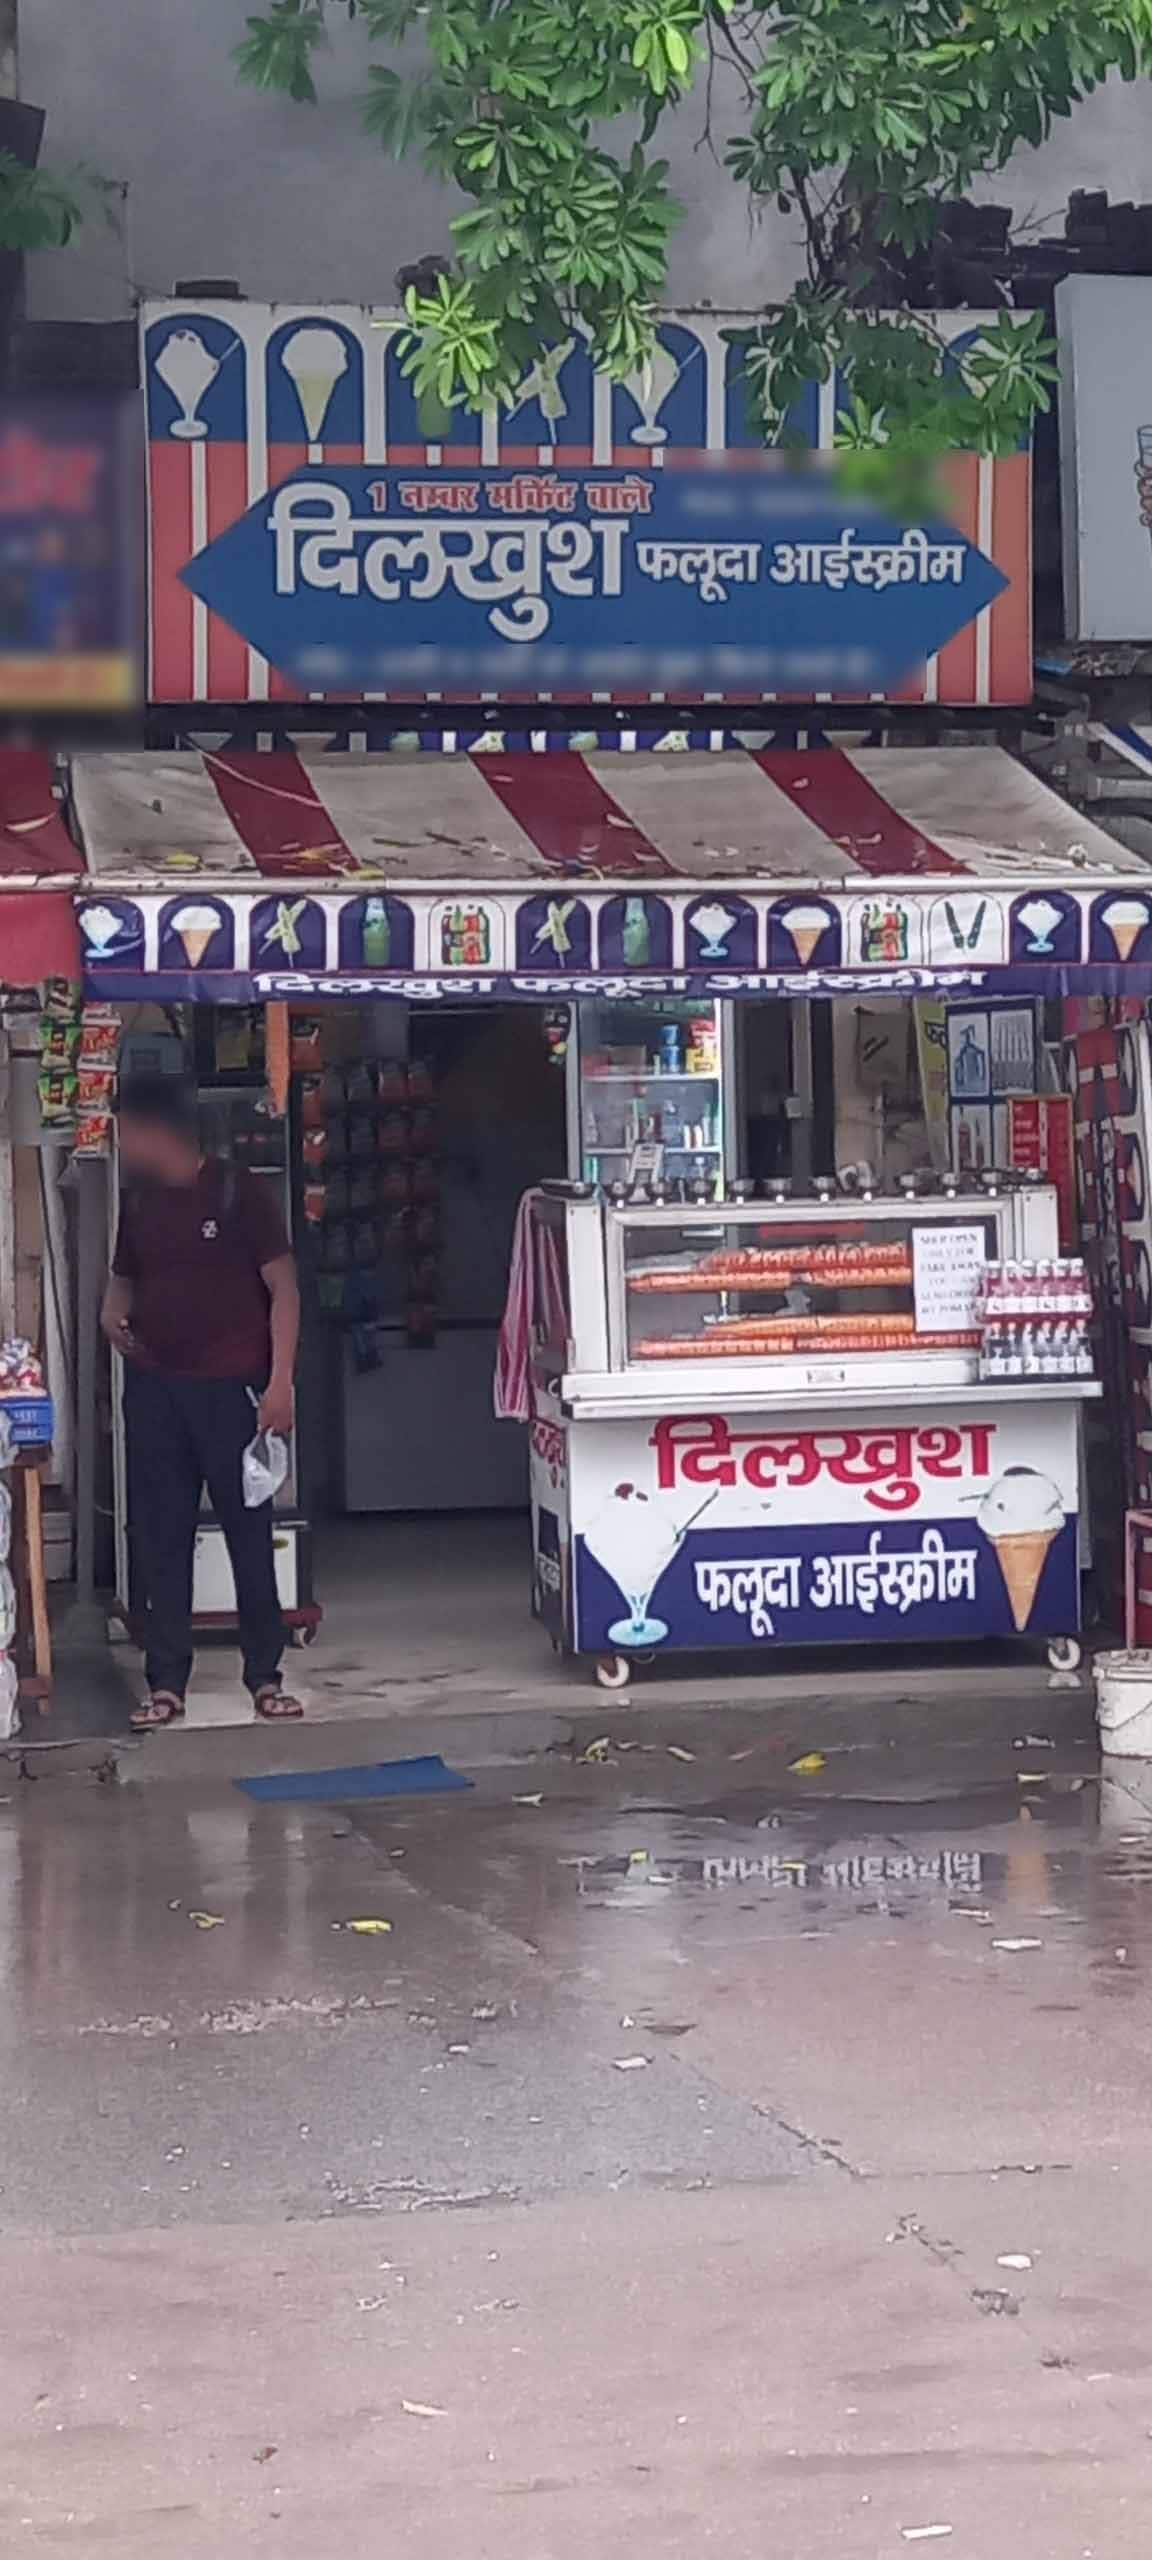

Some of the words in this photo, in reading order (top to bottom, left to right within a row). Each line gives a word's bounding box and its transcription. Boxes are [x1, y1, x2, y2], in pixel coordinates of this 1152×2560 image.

[366, 481, 387, 513] 1
[584, 474, 654, 513] वाले
[267, 481, 630, 643] दिलखुश
[636, 541, 763, 602] फलूदा
[769, 528, 967, 591] आईस्क्रीम
[252, 972, 496, 999] दिलखुश
[510, 976, 691, 998] फलूदा
[705, 968, 988, 991] आईस्क्रीम
[648, 1413, 997, 1511] दिलखुश
[694, 1556, 802, 1637] फलूदा
[809, 1528, 979, 1613] आईस्क्रीम
